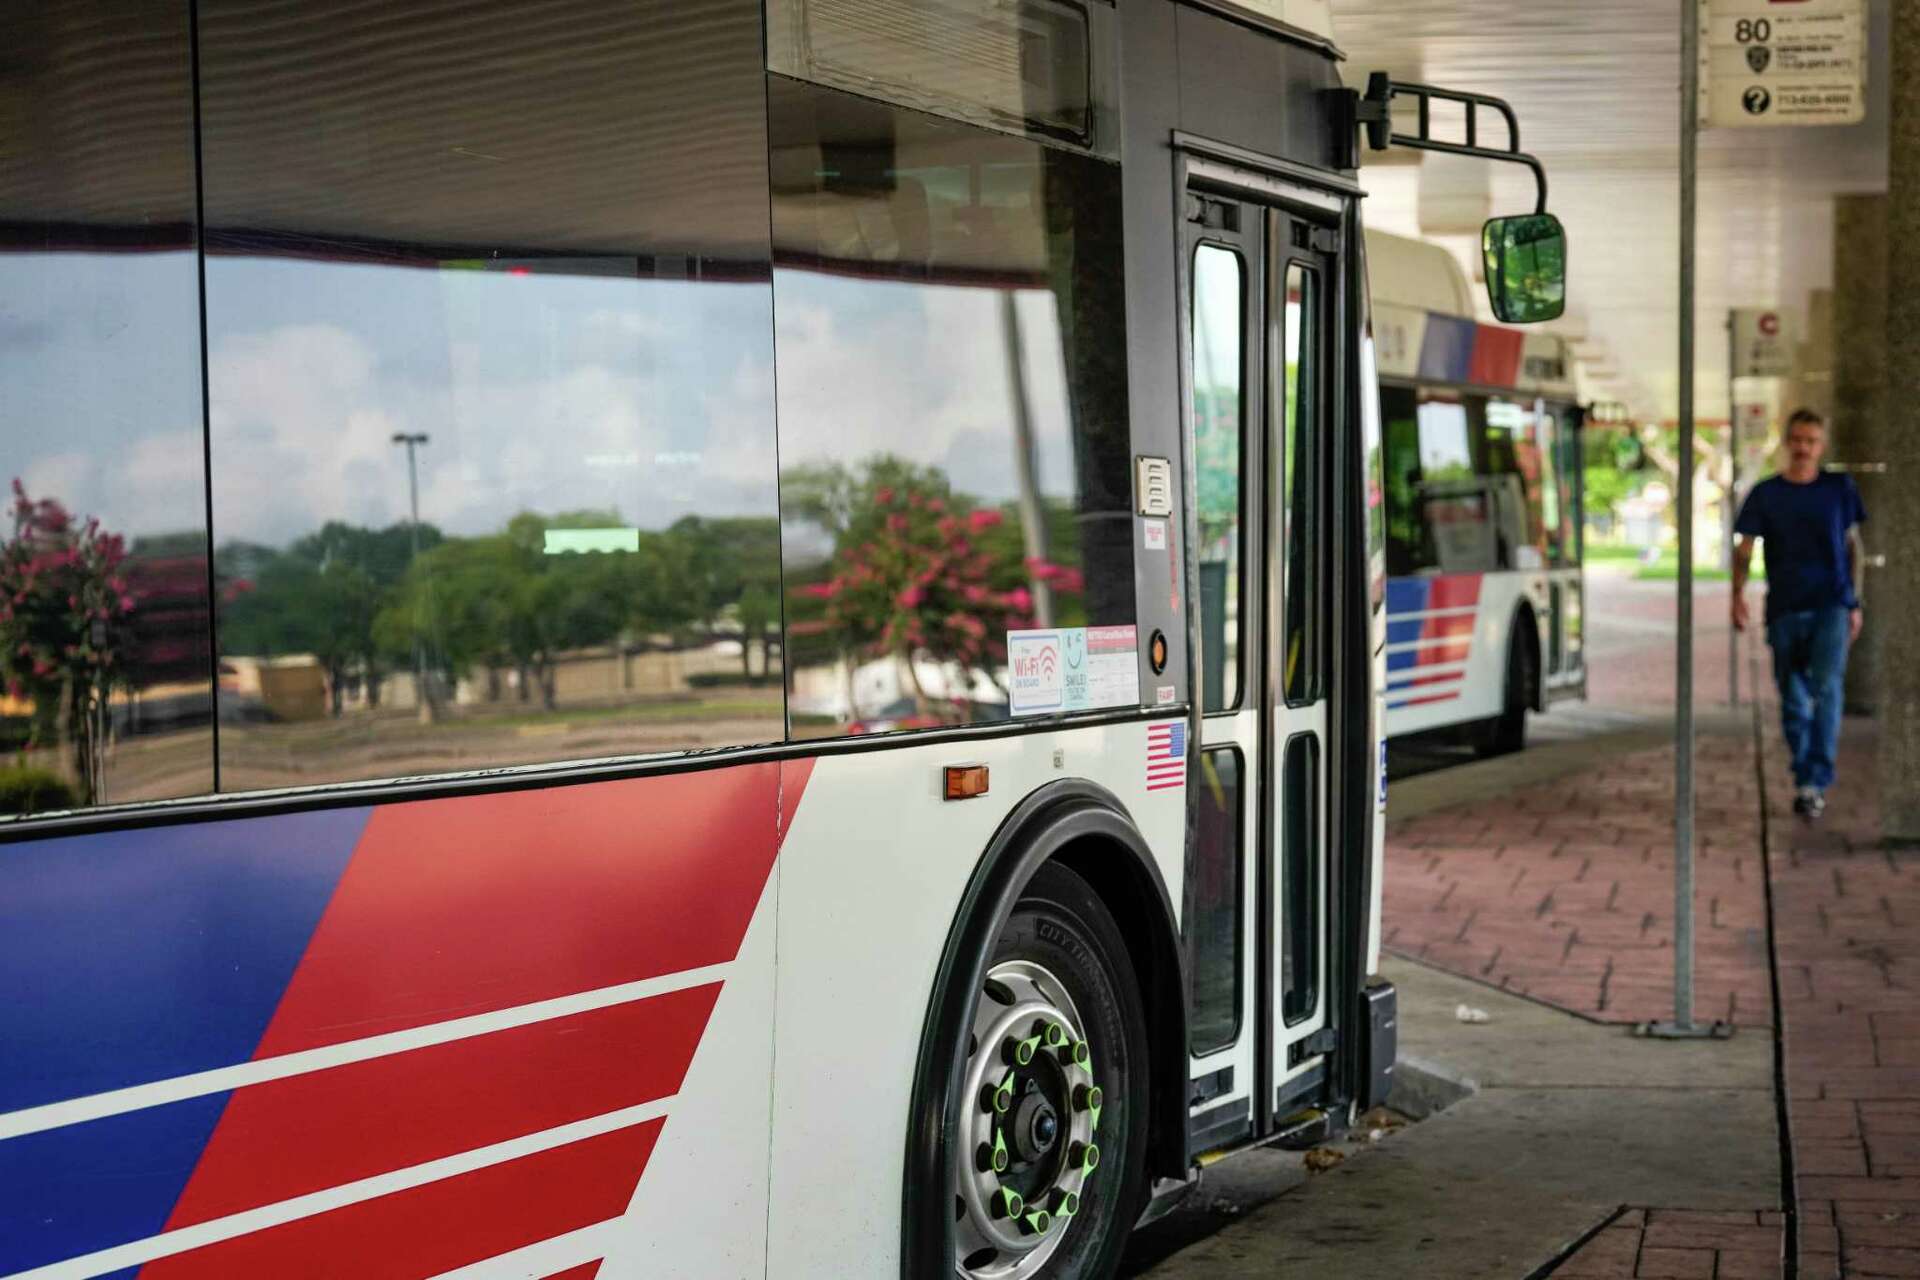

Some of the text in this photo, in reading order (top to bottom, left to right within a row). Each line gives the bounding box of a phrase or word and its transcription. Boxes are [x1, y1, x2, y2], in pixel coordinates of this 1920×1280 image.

[1735, 18, 1771, 43] 80
[1014, 656, 1040, 677] Wi-Fi
[1040, 923, 1070, 946] CITY
